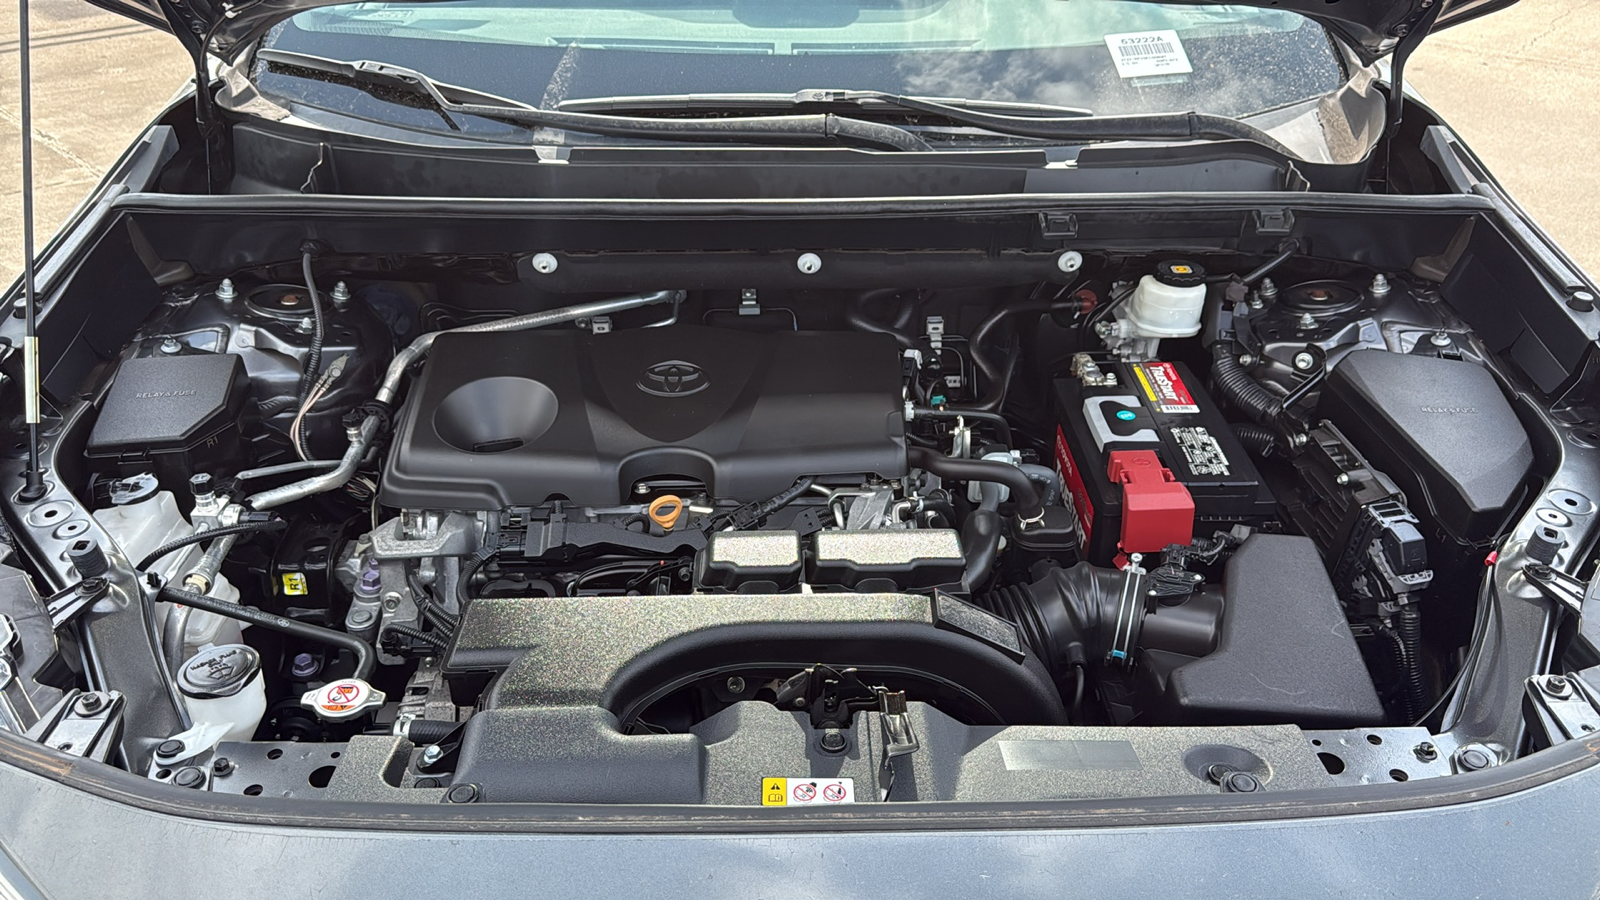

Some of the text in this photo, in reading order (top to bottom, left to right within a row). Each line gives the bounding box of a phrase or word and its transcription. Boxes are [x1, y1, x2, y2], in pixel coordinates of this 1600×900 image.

[136, 391, 165, 399] RELAY
[173, 389, 197, 397] FUSE
[206, 435, 219, 448] R1
[288, 578, 301, 590] R1
